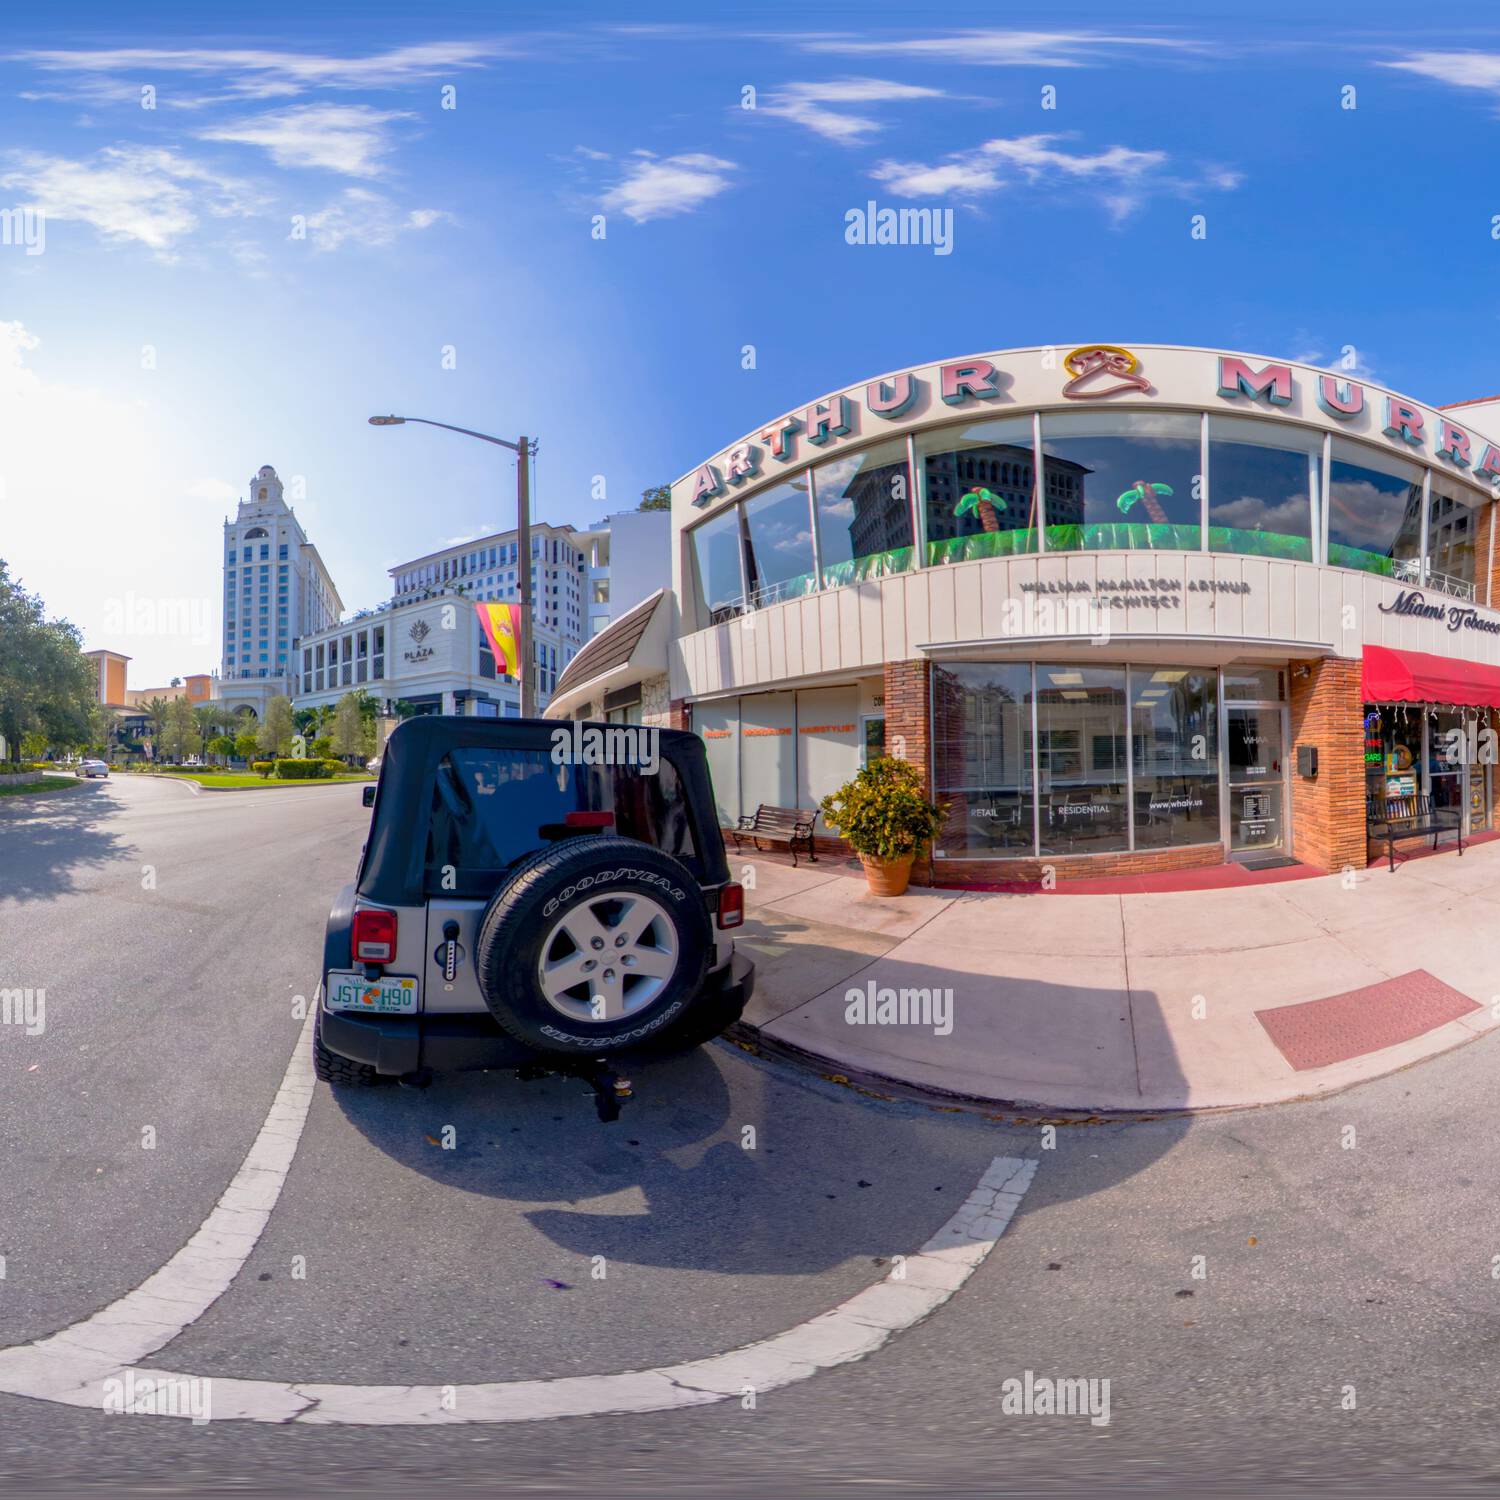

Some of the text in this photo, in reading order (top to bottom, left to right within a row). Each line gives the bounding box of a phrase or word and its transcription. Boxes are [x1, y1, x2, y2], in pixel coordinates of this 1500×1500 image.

[691, 360, 1000, 507] ARTHUR
[1020, 578, 1251, 595] WILLIAM HAMILTON ARTHUR
[1378, 590, 1500, 634] Miami Tobacco
[404, 648, 434, 660] PLAZA
[970, 808, 999, 817] RETAIL
[1058, 804, 1110, 816] RESIDENTIAL
[542, 867, 686, 917] GOODYEAR
[333, 985, 411, 1006] JST H90
[540, 1001, 682, 1047] WRANGLER
